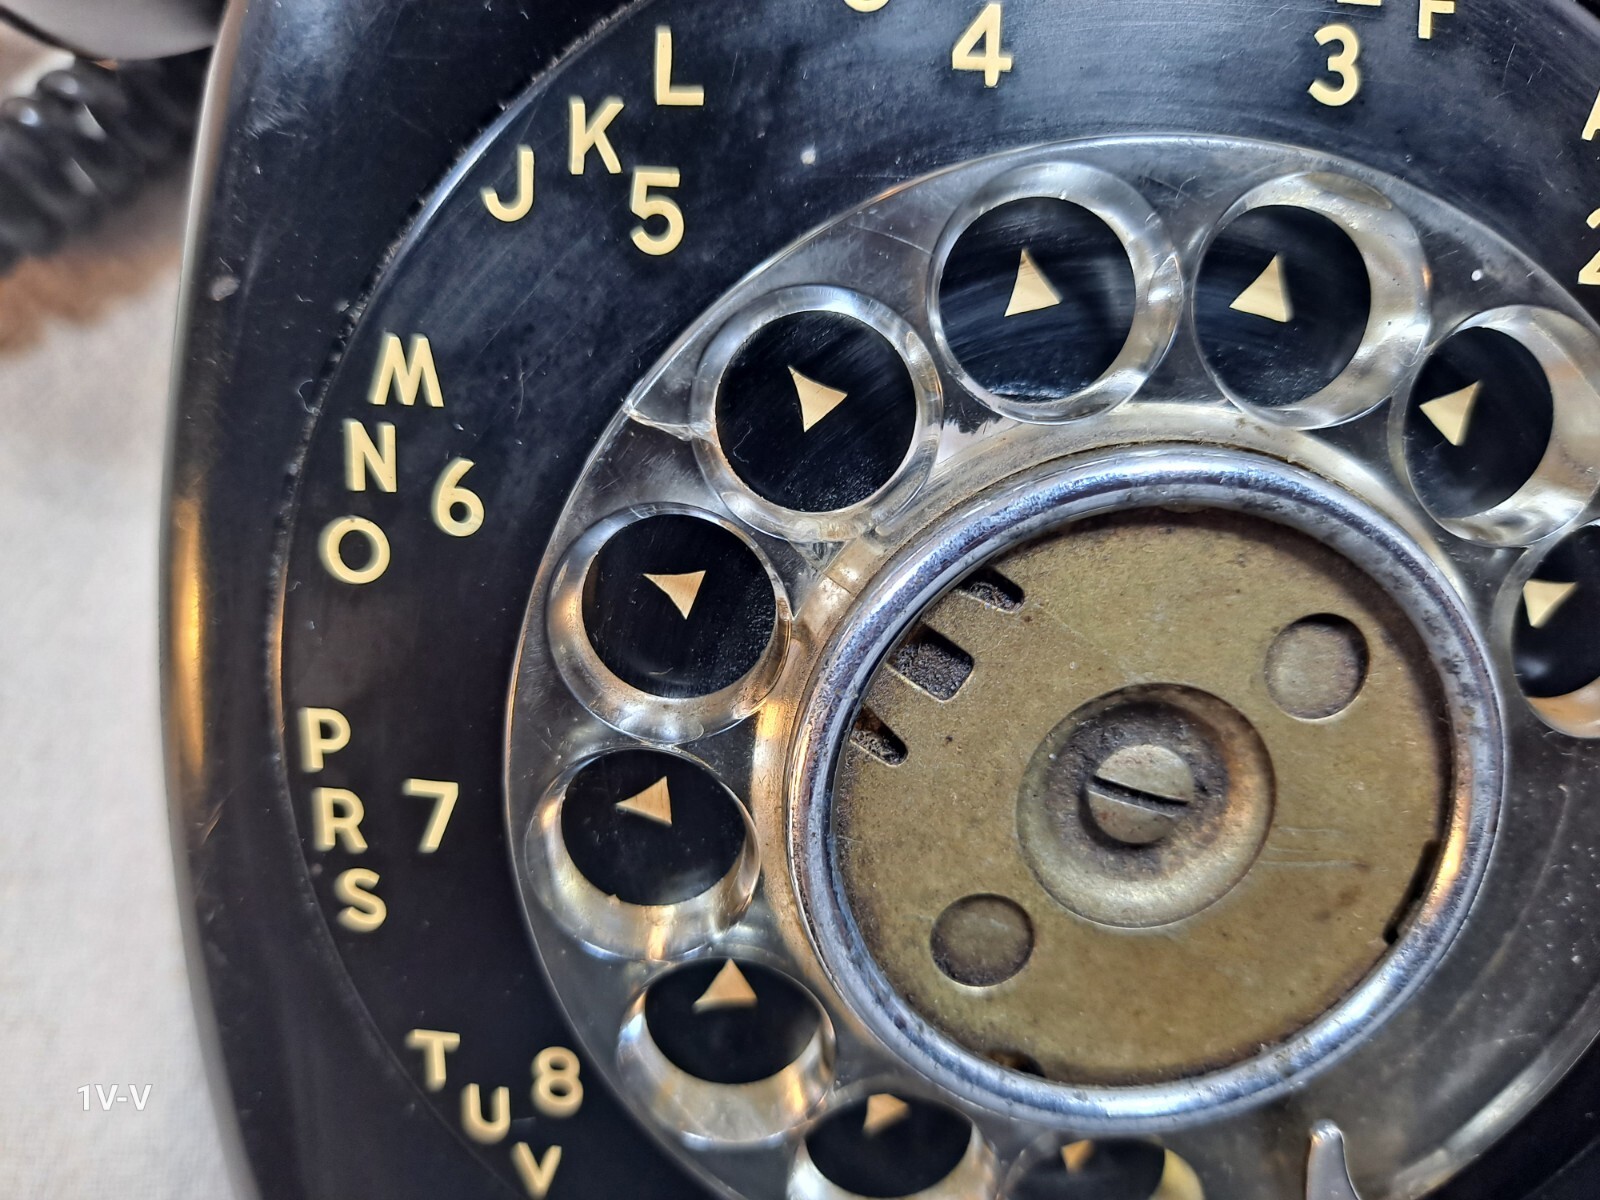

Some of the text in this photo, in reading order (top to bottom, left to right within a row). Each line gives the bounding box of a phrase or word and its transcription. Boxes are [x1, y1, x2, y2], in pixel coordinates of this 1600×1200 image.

[951, 2, 1012, 88] 4
[1307, 23, 1360, 107] 3
[481, 25, 706, 223] J K L
[629, 167, 685, 256] 5
[319, 333, 445, 585] M N O
[430, 458, 485, 537] 6
[300, 707, 387, 932] P R S
[402, 779, 459, 853] 7
[406, 1029, 562, 1198] T U V
[531, 1046, 584, 1117] 8
